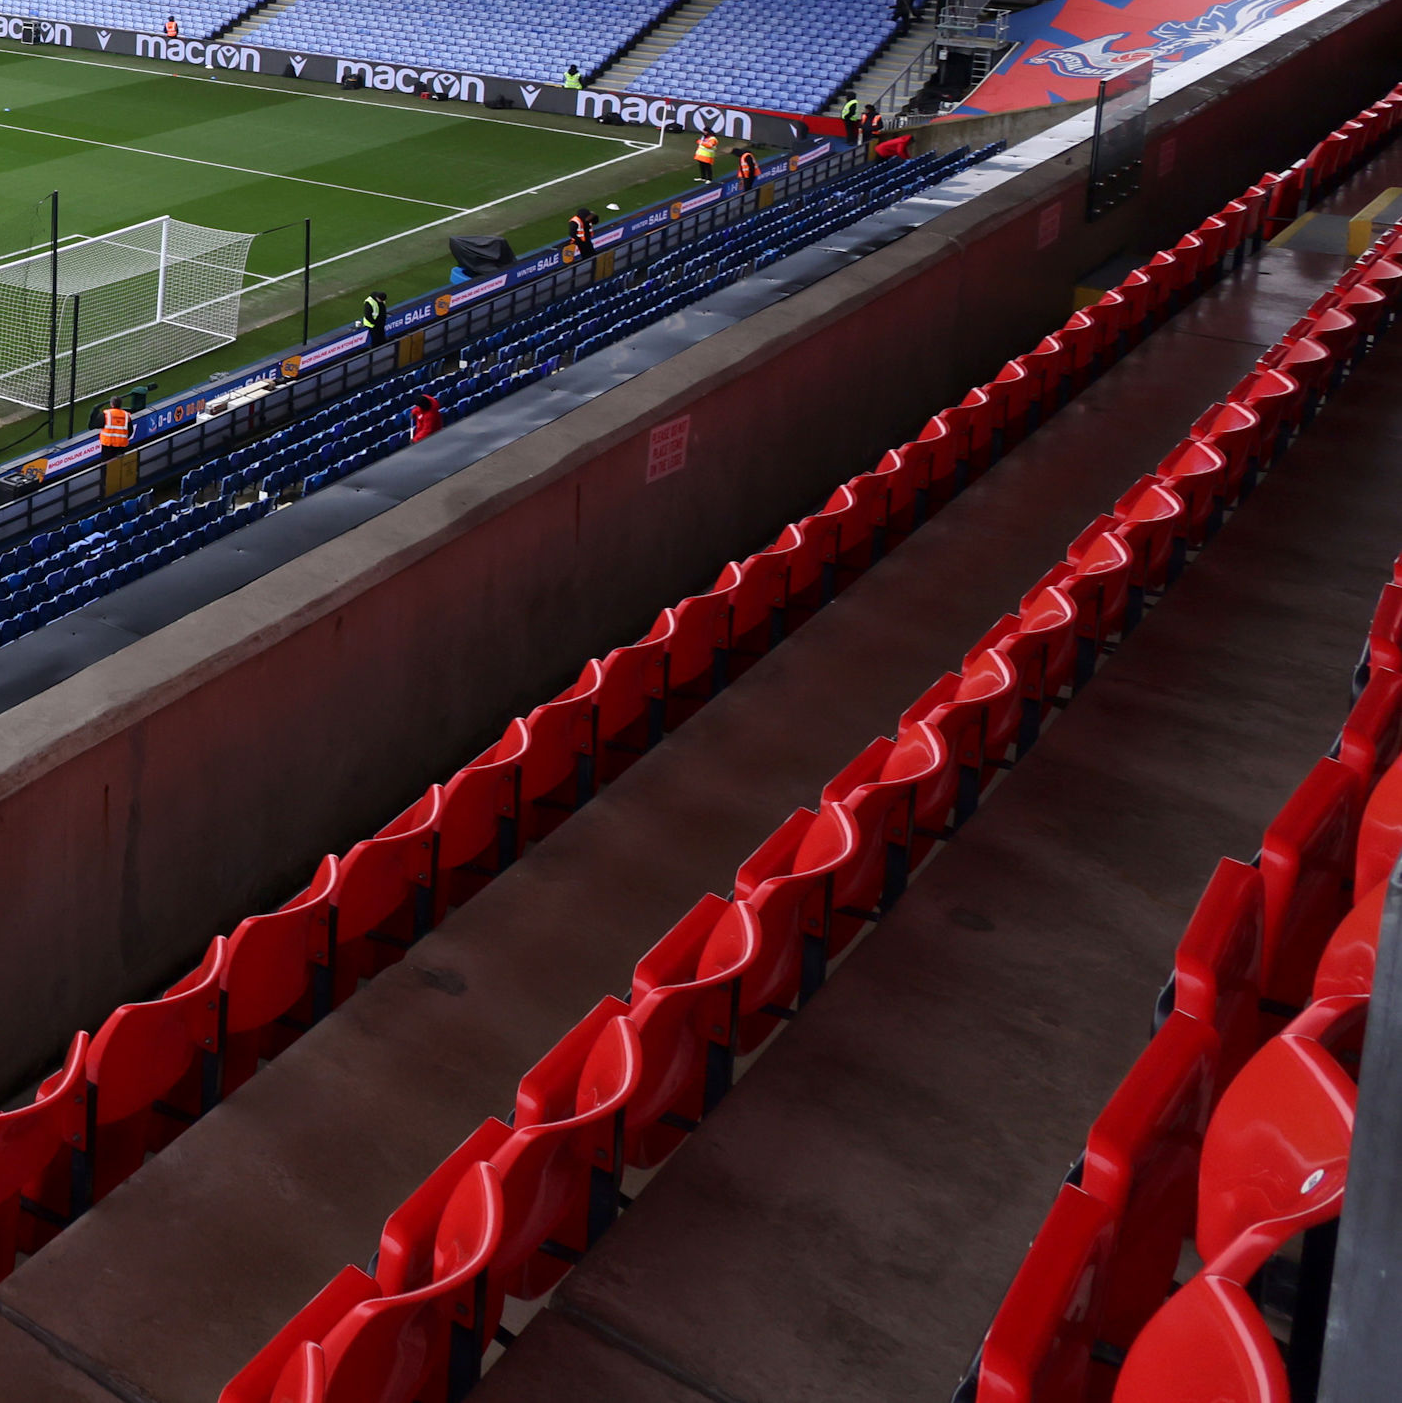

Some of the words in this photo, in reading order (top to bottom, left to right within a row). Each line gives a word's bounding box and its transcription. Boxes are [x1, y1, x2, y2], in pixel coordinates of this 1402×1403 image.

[135, 33, 260, 73] macron
[336, 60, 485, 104] macron
[577, 90, 751, 141] macron
[771, 161, 787, 177] SALE
[649, 209, 668, 225] SALE
[537, 253, 559, 271] SALE
[405, 305, 431, 325] SALE
